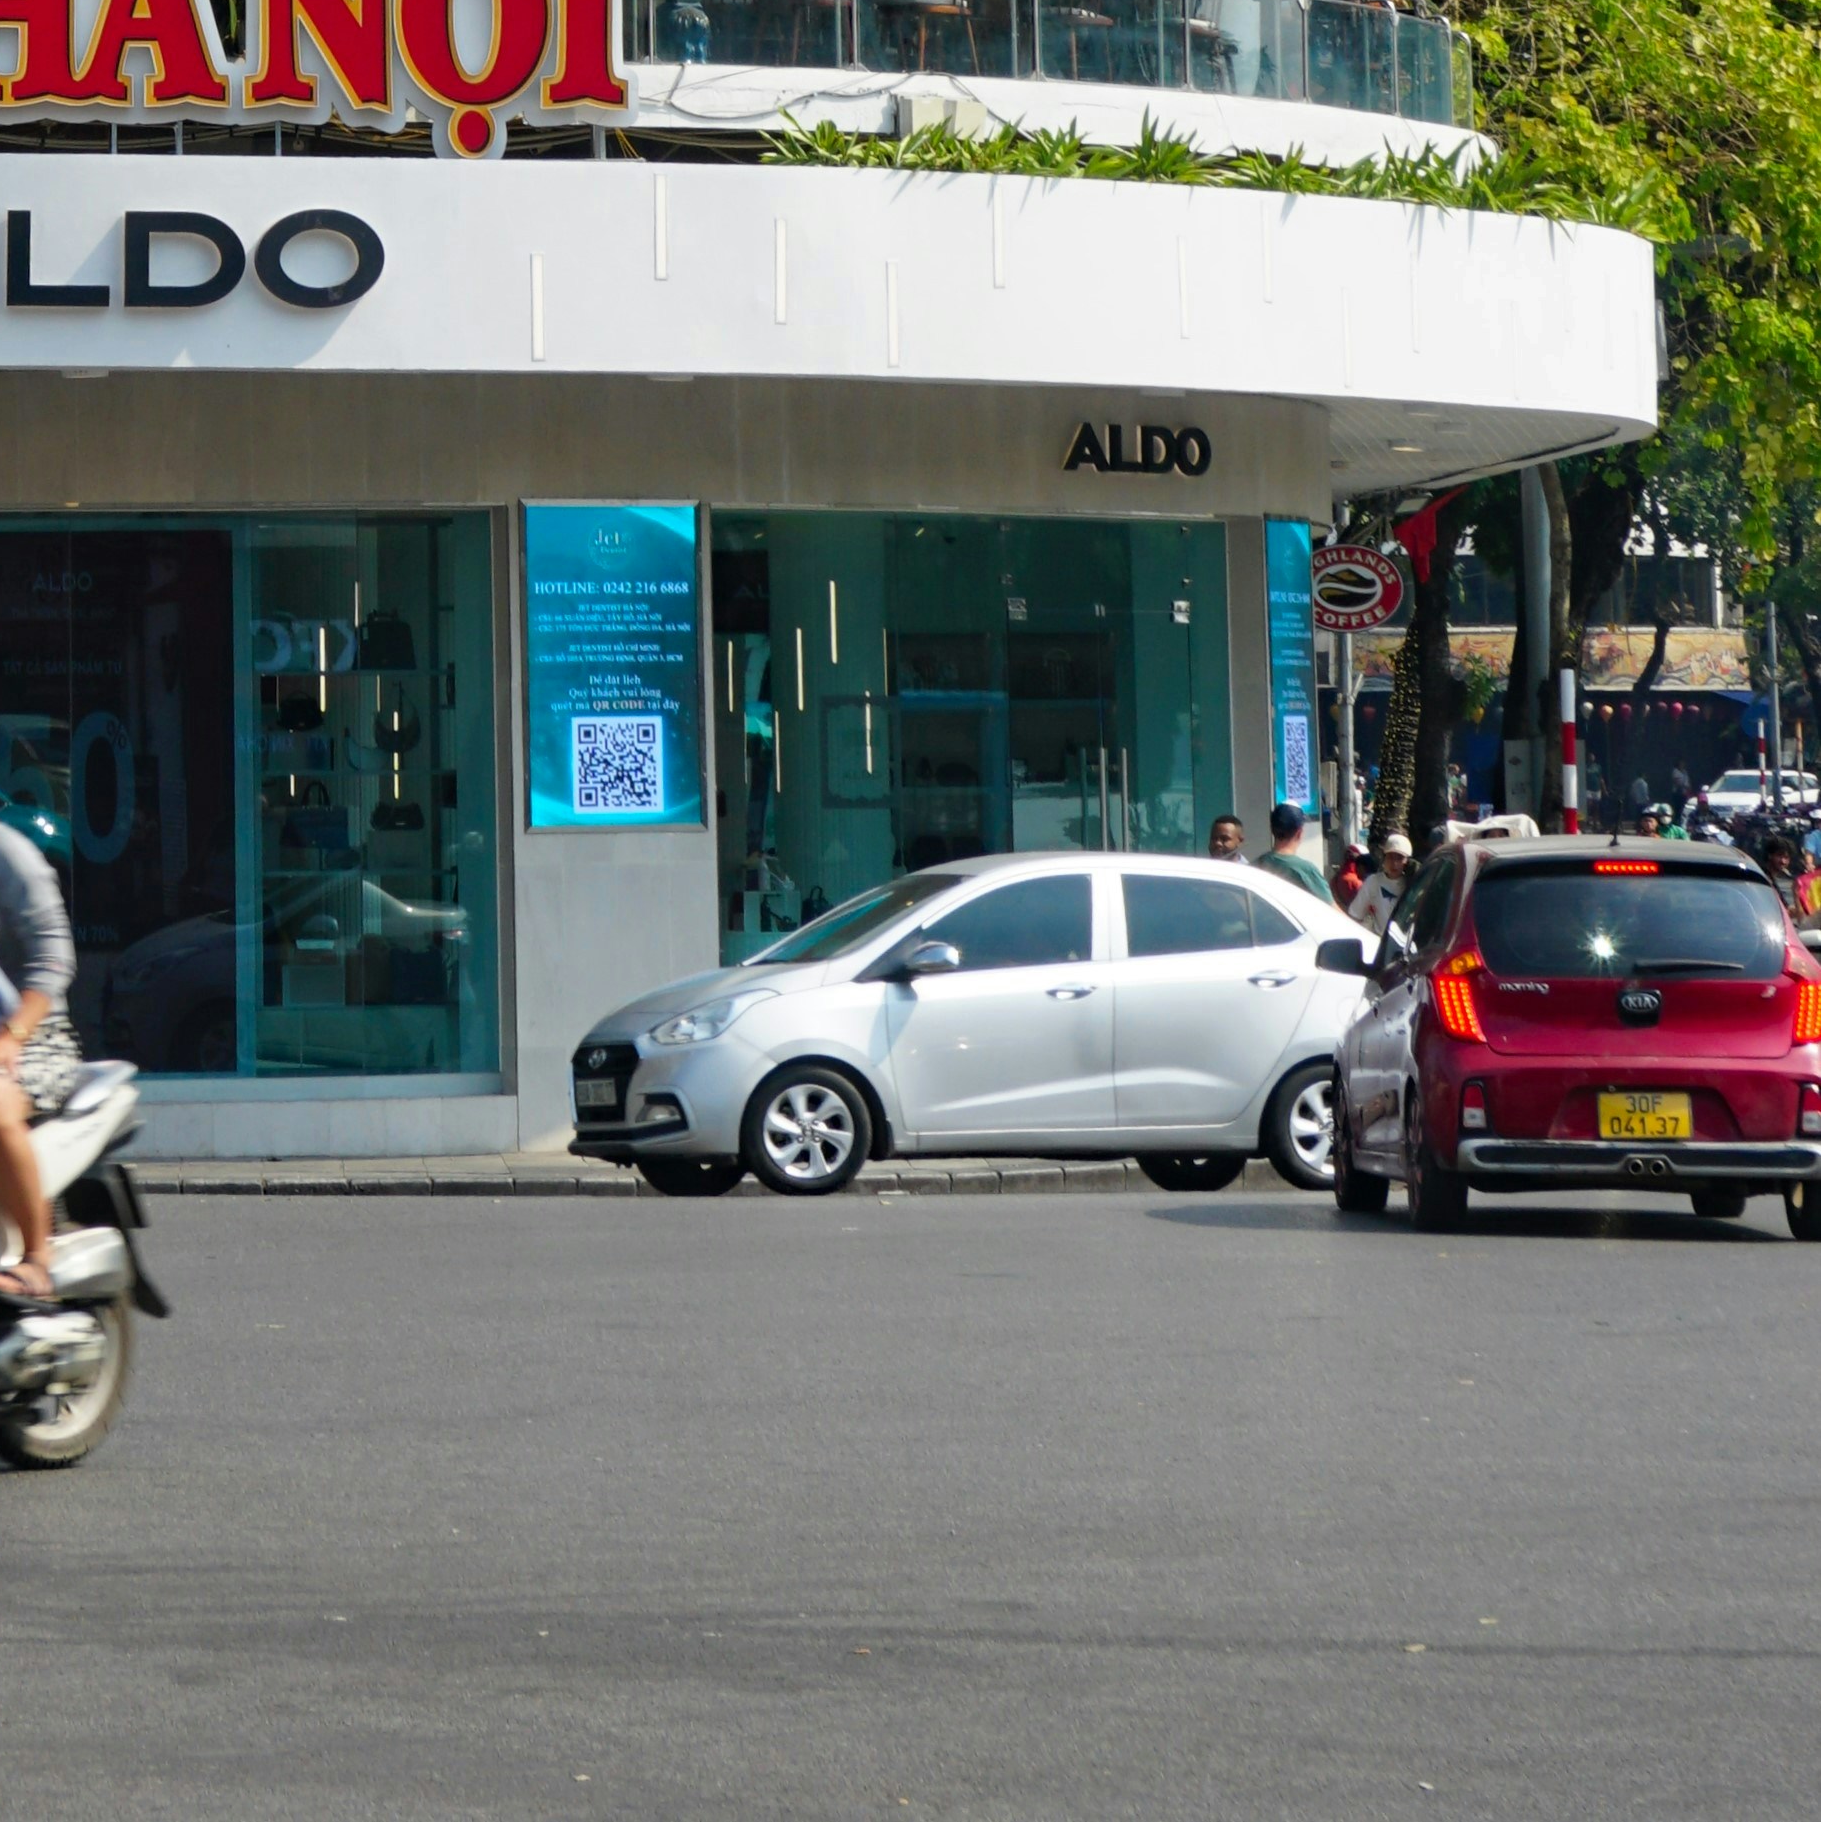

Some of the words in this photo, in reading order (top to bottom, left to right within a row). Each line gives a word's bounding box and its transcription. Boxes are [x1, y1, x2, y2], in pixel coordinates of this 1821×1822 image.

[1063, 421, 1213, 477] ALDO
[32, 570, 93, 592] ALDO
[534, 582, 600, 595] HOTLINE:
[603, 581, 632, 595] 0242
[636, 582, 657, 594] 216
[660, 581, 689, 594] 6868
[592, 700, 610, 711] QR
[612, 700, 645, 710] CODE
[1498, 981, 1550, 995] morning
[1626, 994, 1655, 1010] KIA
[1626, 1095, 1663, 1113] 30F
[1610, 1117, 1680, 1136] 041.37
